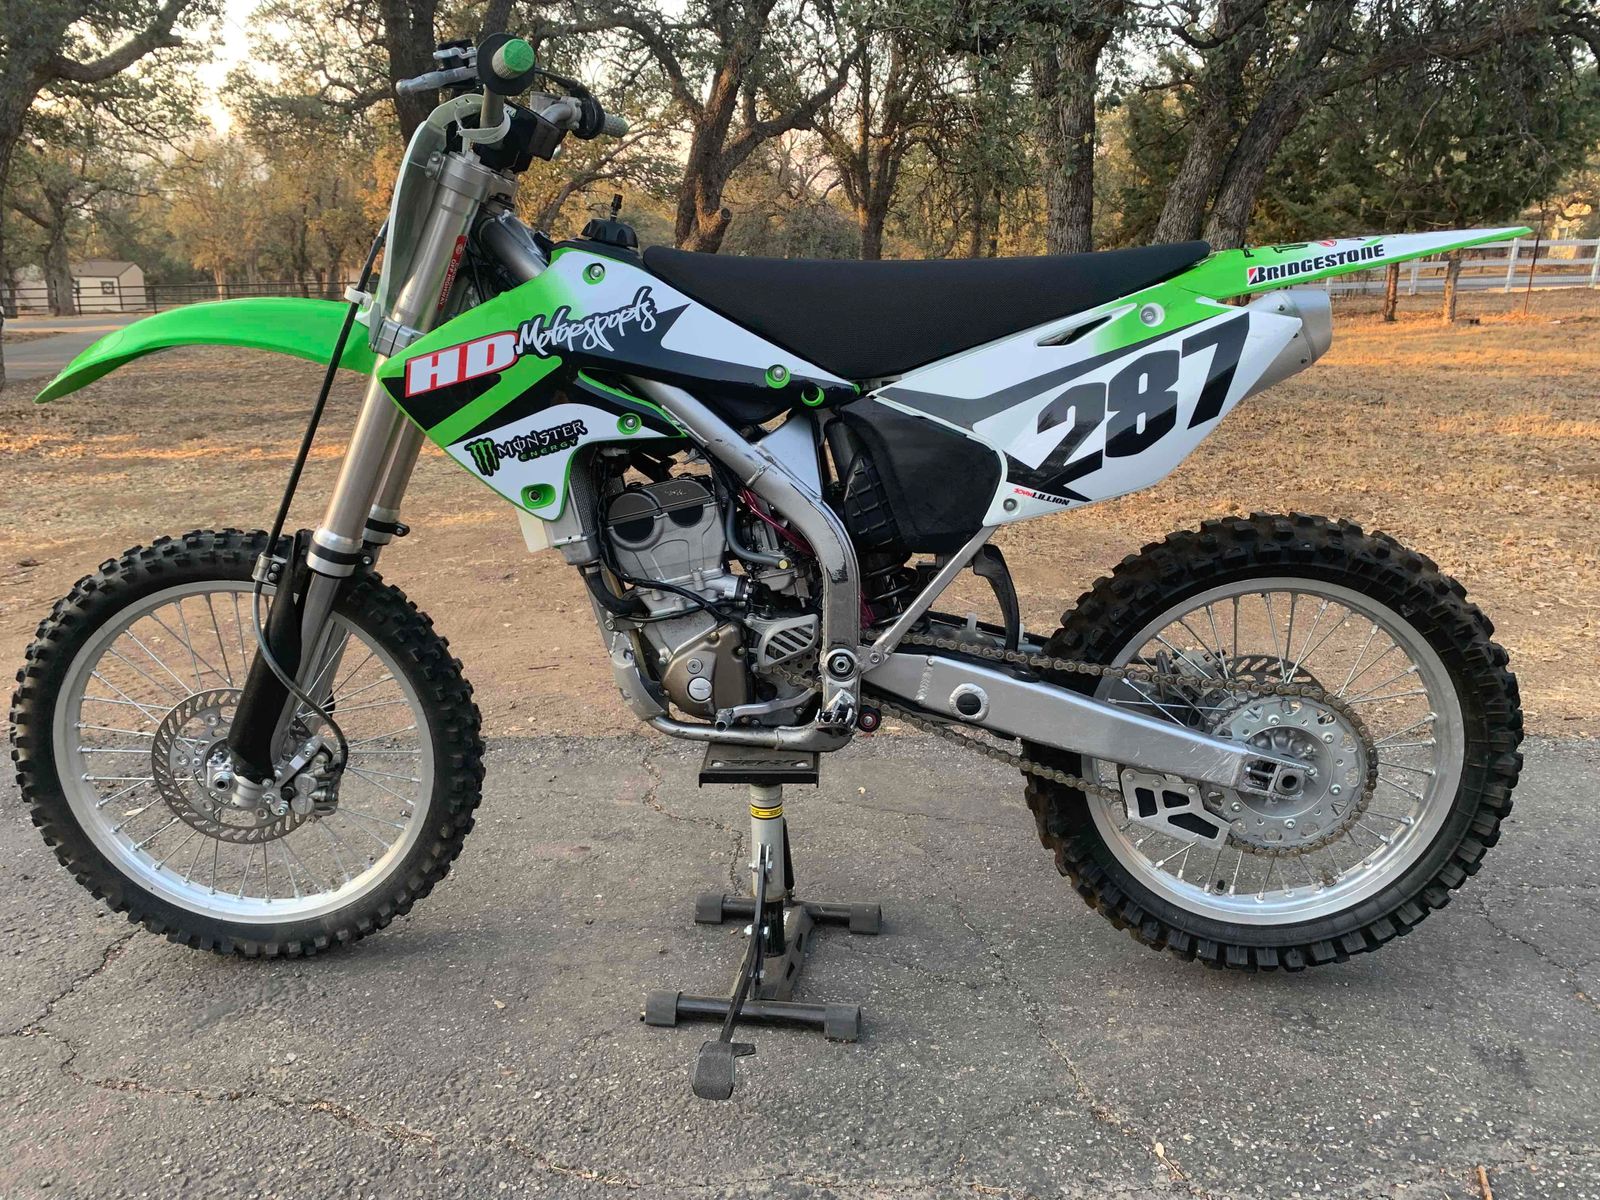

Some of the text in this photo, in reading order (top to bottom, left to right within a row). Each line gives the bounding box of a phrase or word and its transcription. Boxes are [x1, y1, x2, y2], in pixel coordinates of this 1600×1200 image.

[1249, 244, 1385, 285] BRIDGESTONE
[408, 332, 518, 396] HD
[1036, 311, 1250, 487] 287
[496, 421, 587, 457] MONSTER
[520, 438, 577, 460] ENERGY
